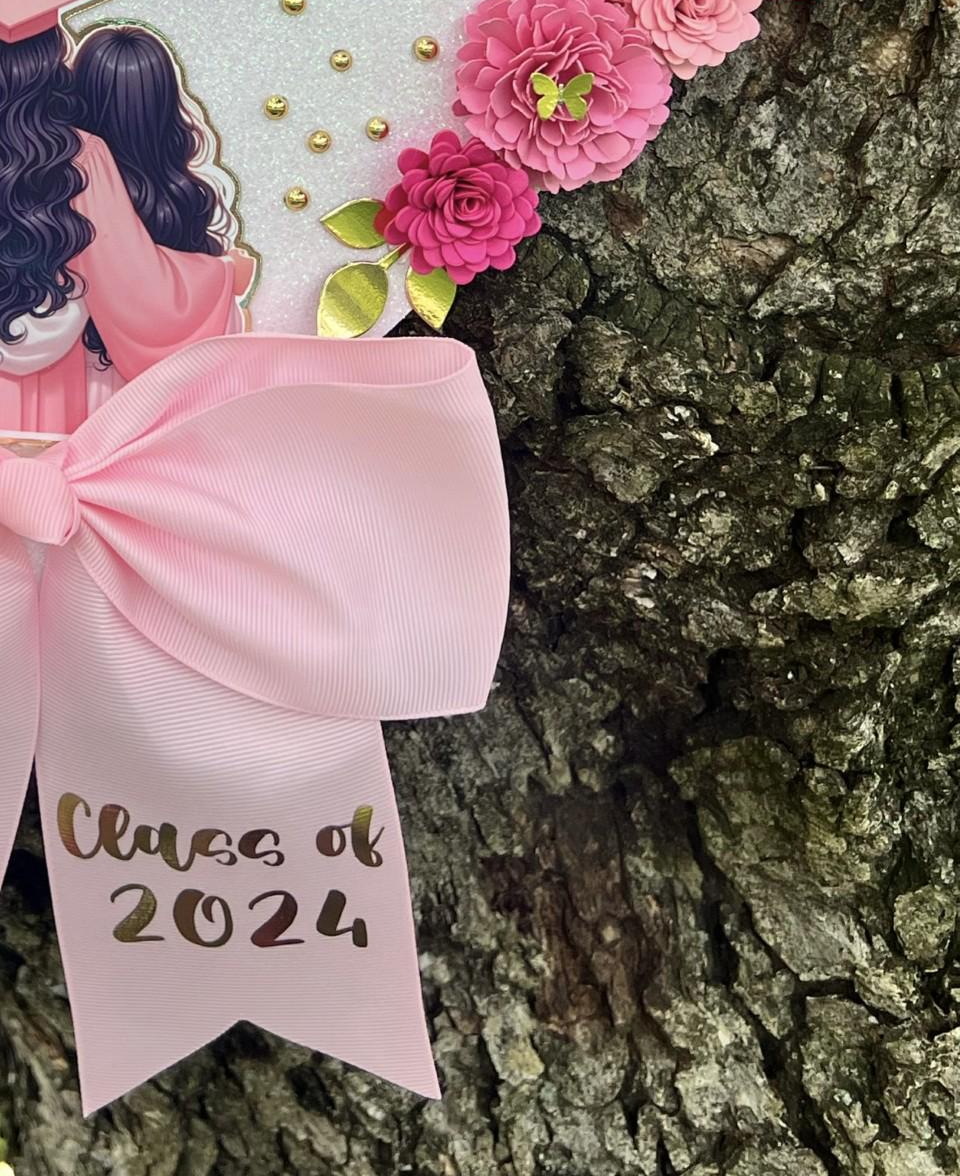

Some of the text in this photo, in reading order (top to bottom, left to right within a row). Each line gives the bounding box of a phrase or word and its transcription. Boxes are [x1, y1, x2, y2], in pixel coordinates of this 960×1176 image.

[56, 791, 385, 872] Class of
[110, 883, 368, 948] 2024
